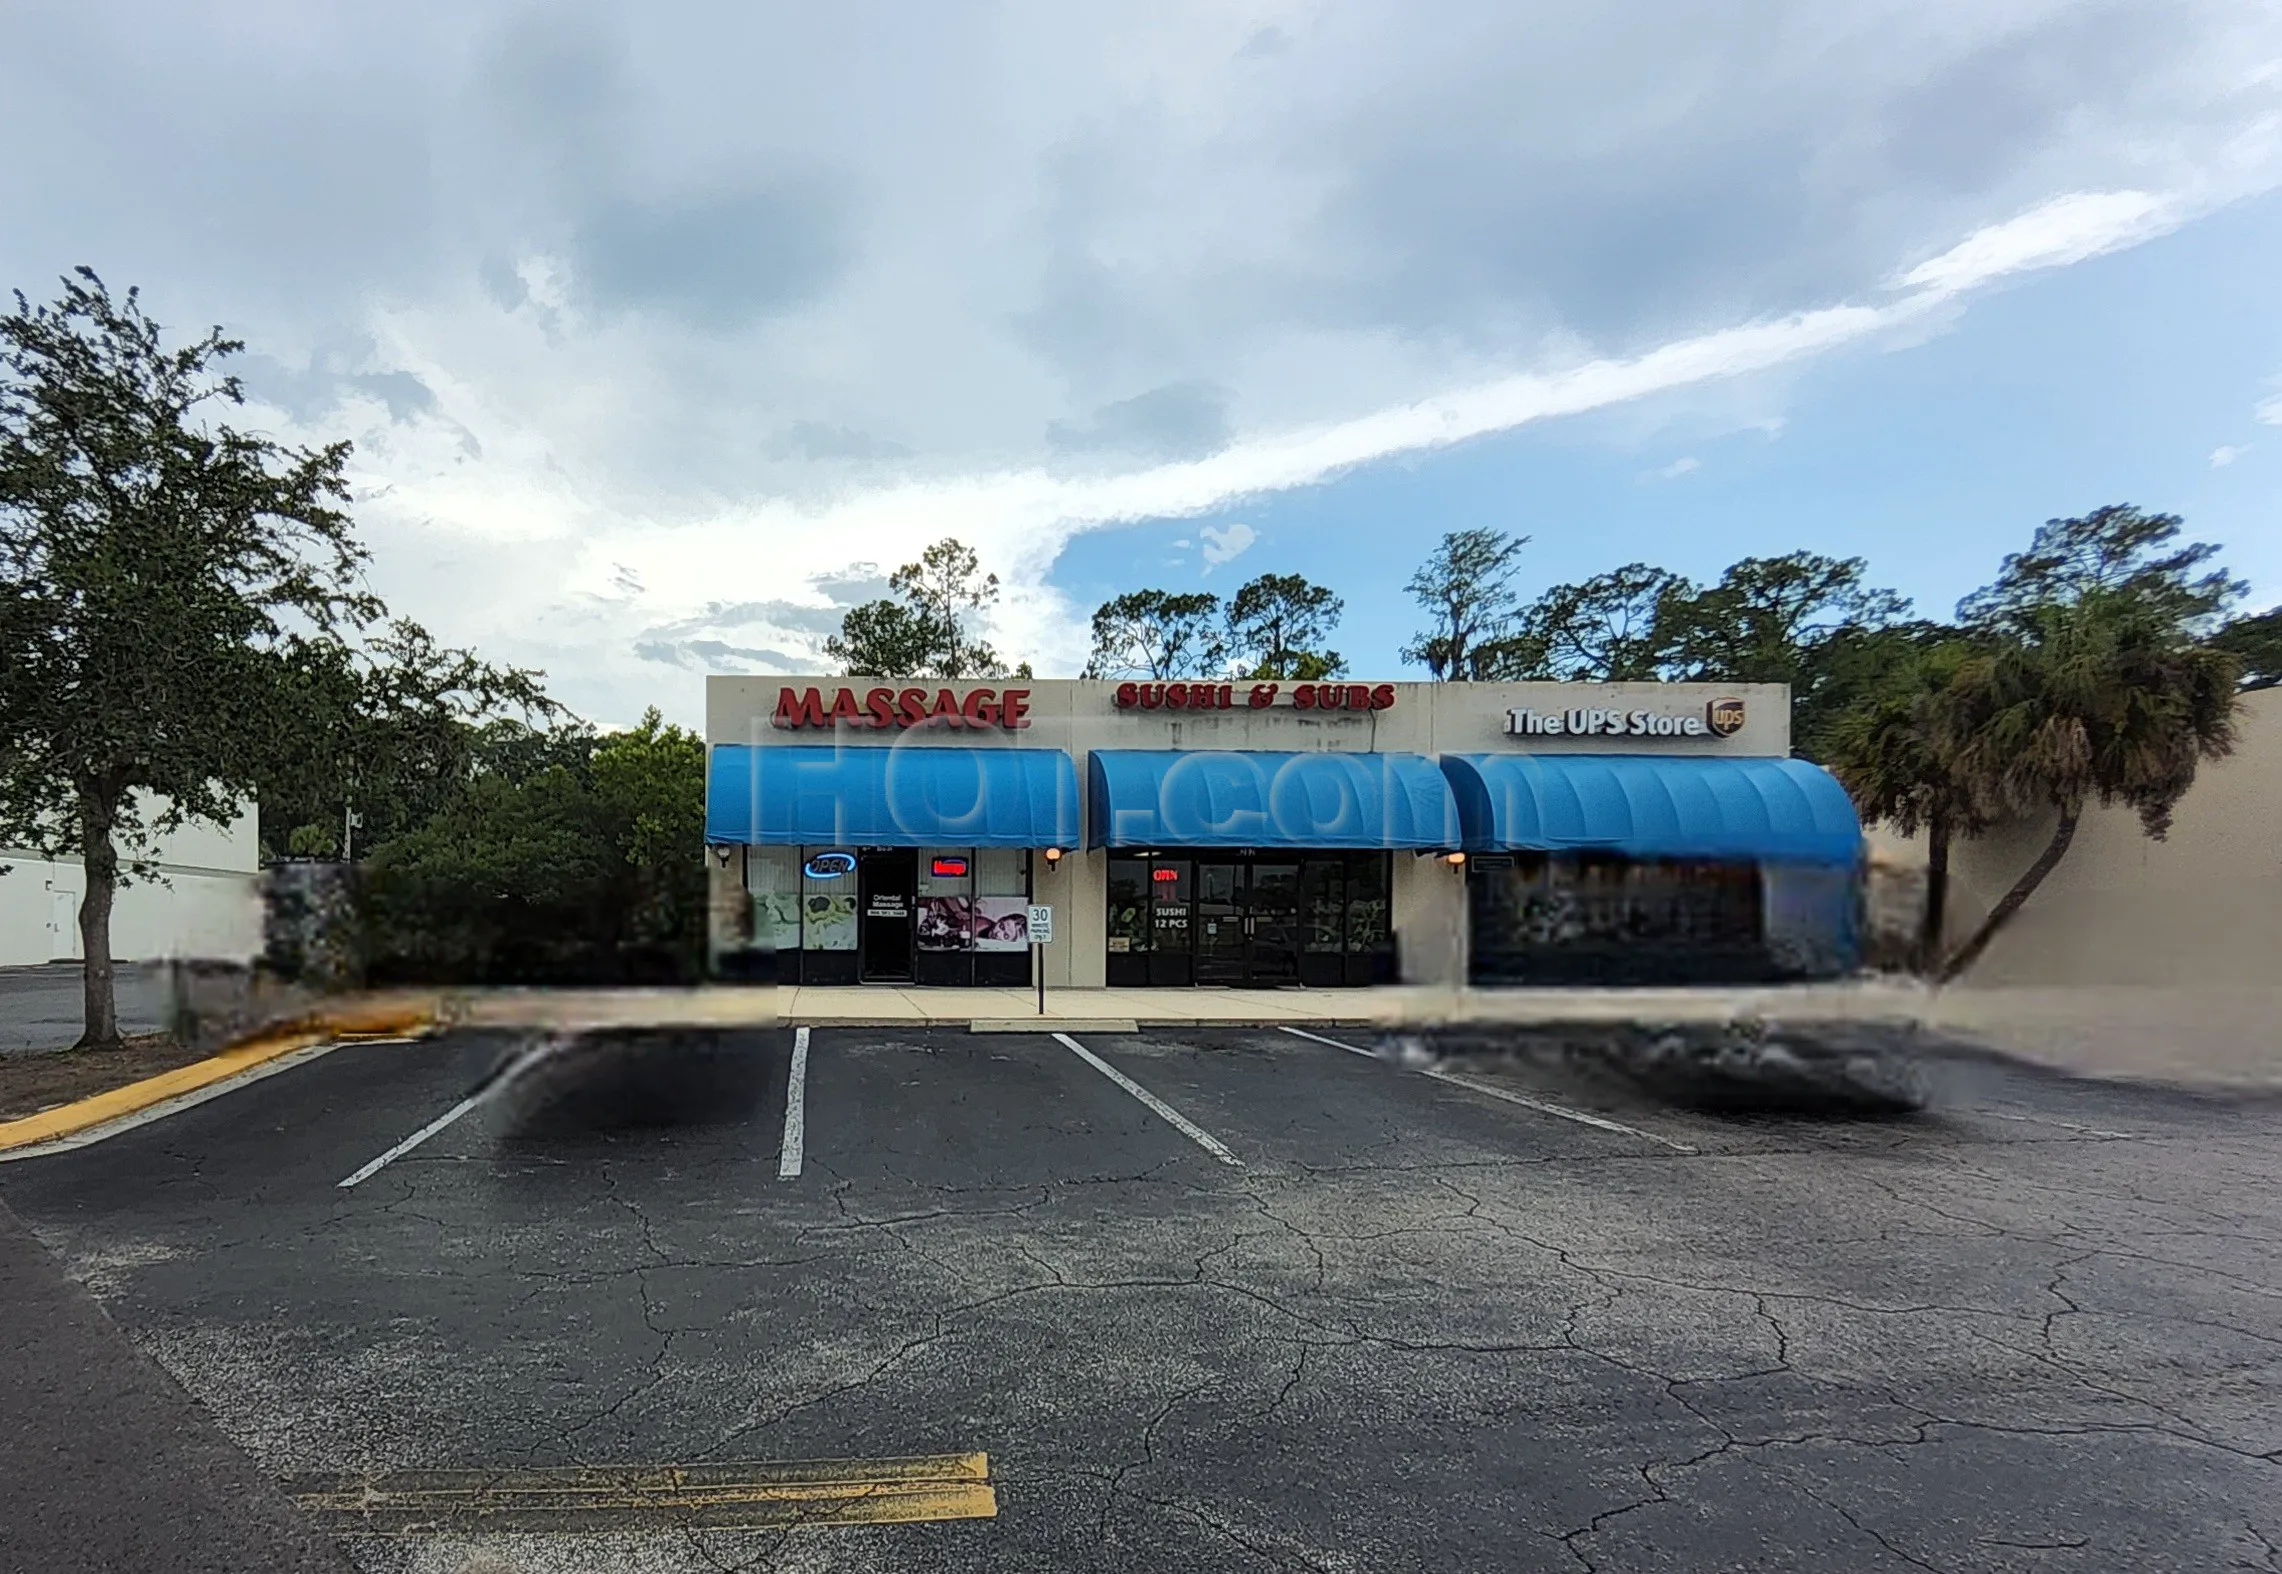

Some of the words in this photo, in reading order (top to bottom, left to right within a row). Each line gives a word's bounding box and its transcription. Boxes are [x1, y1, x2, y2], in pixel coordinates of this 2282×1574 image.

[1116, 682, 1234, 710] SUSHI
[1249, 682, 1279, 709] &
[1293, 683, 1396, 711] SUBS
[774, 686, 1032, 730] MASSAGE
[1508, 707, 1562, 735] The
[1566, 707, 1623, 735] UPS
[1630, 707, 1701, 736] Store
[1714, 708, 1745, 731] ups
[810, 858, 849, 873] OPEN
[1032, 908, 1048, 922] 30
[1155, 907, 1187, 917] SUSHI
[1154, 919, 1167, 928] 12
[1168, 919, 1188, 928] PCS
